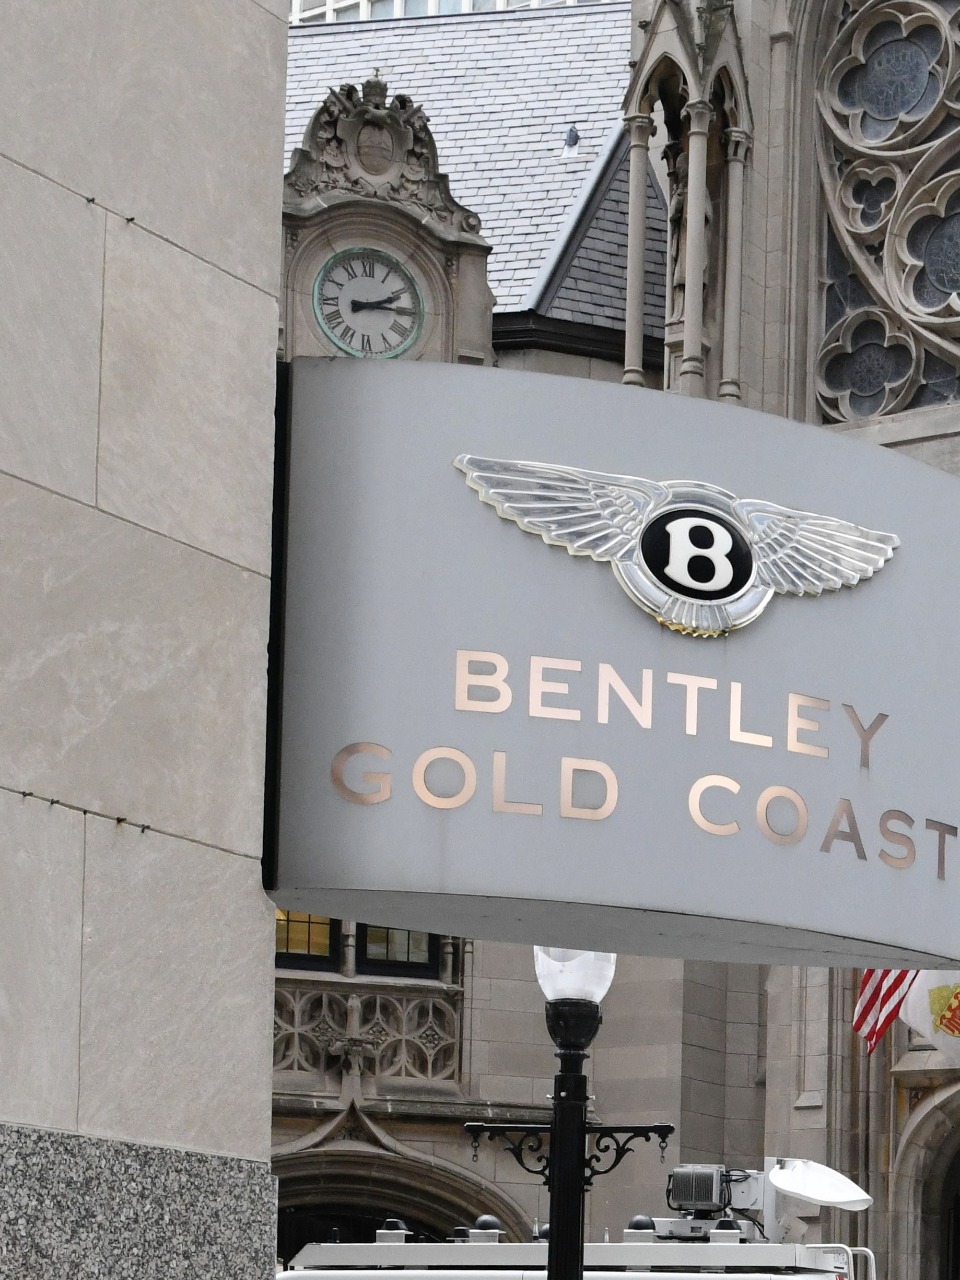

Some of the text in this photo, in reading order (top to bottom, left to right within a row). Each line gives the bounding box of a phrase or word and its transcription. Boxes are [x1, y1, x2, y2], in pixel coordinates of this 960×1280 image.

[341, 261, 358, 281] XI
[360, 260, 375, 278] XII
[664, 516, 734, 591] B
[454, 648, 890, 770] BENTLEY
[330, 741, 959, 882] GOLD COAST
